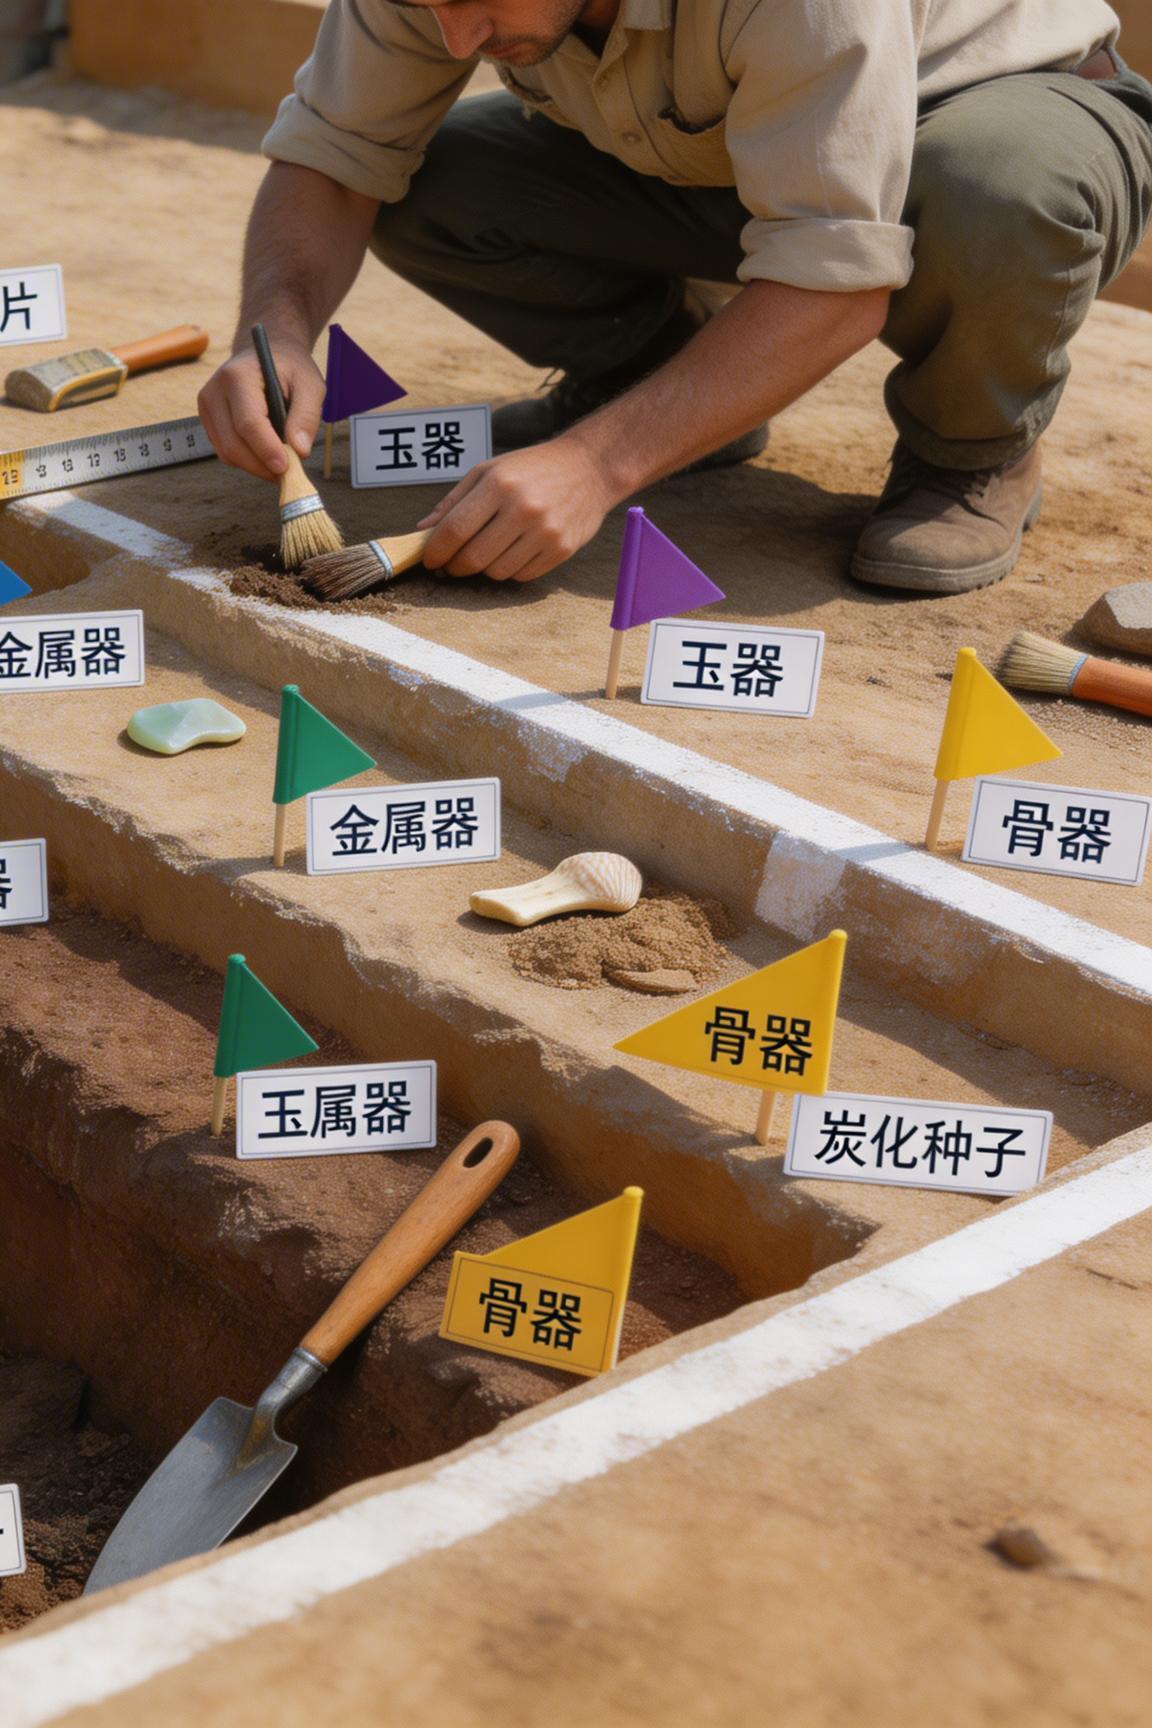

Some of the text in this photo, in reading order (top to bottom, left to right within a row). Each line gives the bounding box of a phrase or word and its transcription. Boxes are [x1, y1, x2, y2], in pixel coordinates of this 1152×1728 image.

[375, 421, 465, 471] 玉器
[672, 641, 784, 698] 玉器
[329, 797, 480, 857] 金属器
[1002, 799, 1111, 864] 骨器
[704, 1006, 813, 1076] 骨器
[257, 1080, 412, 1139] 玉属器
[814, 1109, 1026, 1178] 炭化种子
[478, 1278, 582, 1352] 骨器
